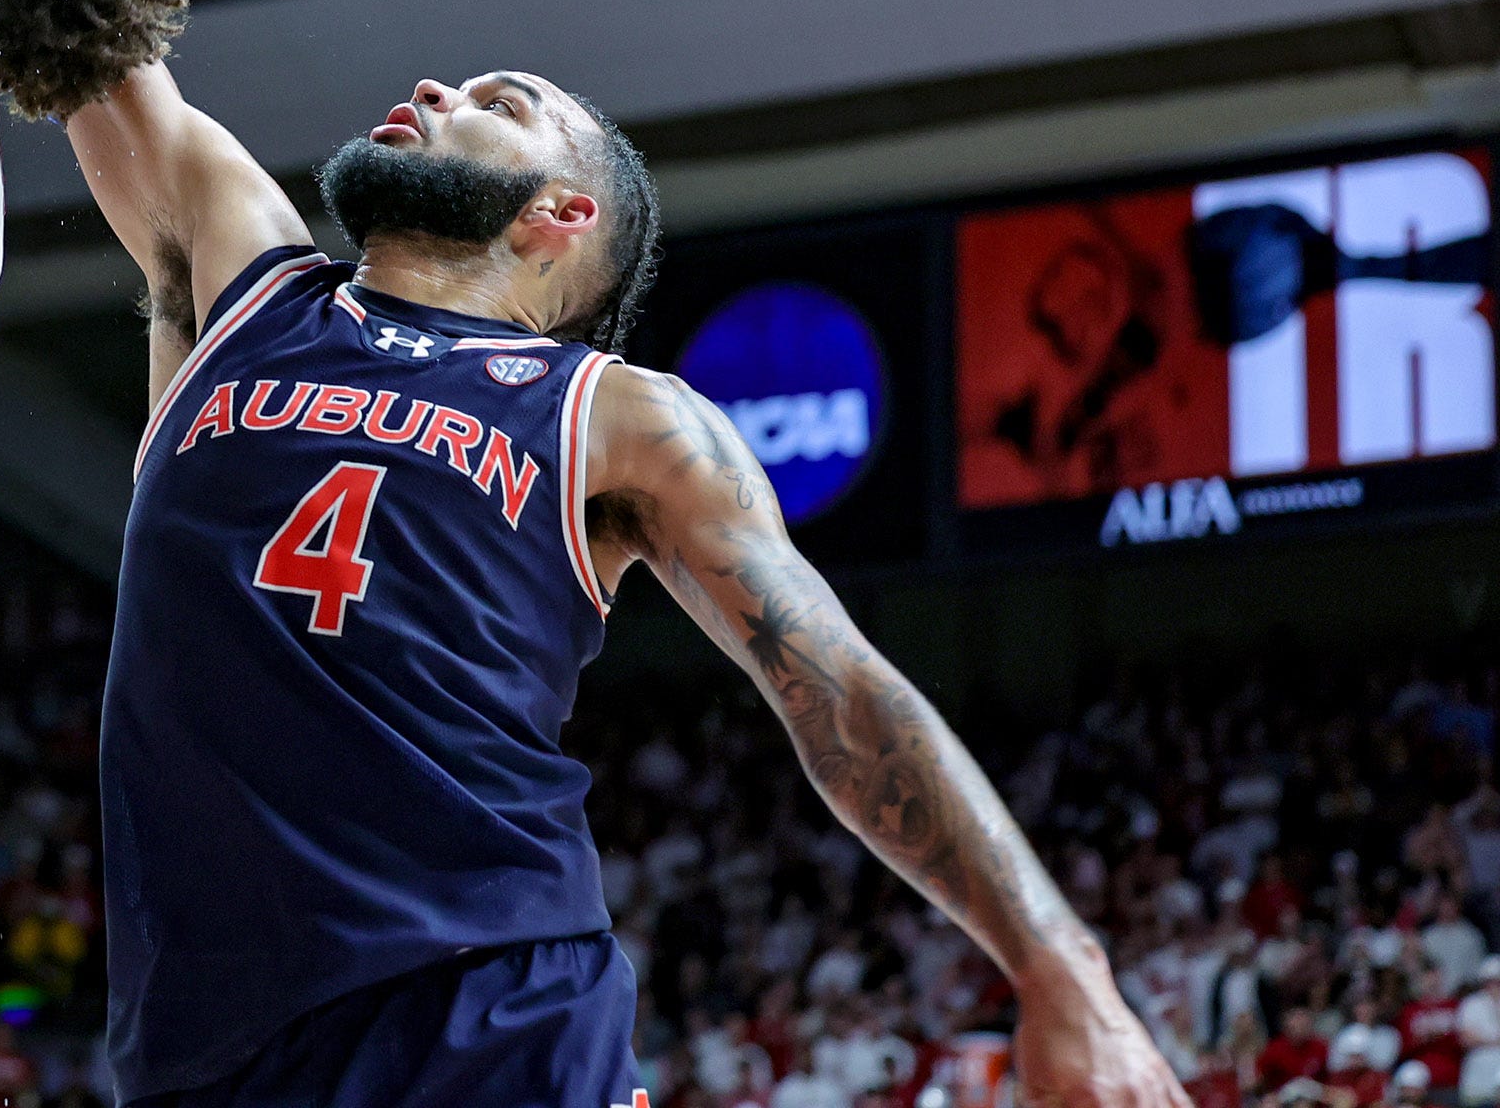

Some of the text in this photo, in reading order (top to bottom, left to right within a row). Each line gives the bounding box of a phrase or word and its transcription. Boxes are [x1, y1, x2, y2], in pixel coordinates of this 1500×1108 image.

[490, 357, 543, 383] SEC
[175, 379, 540, 531] AUBURN
[253, 460, 387, 637] 4
